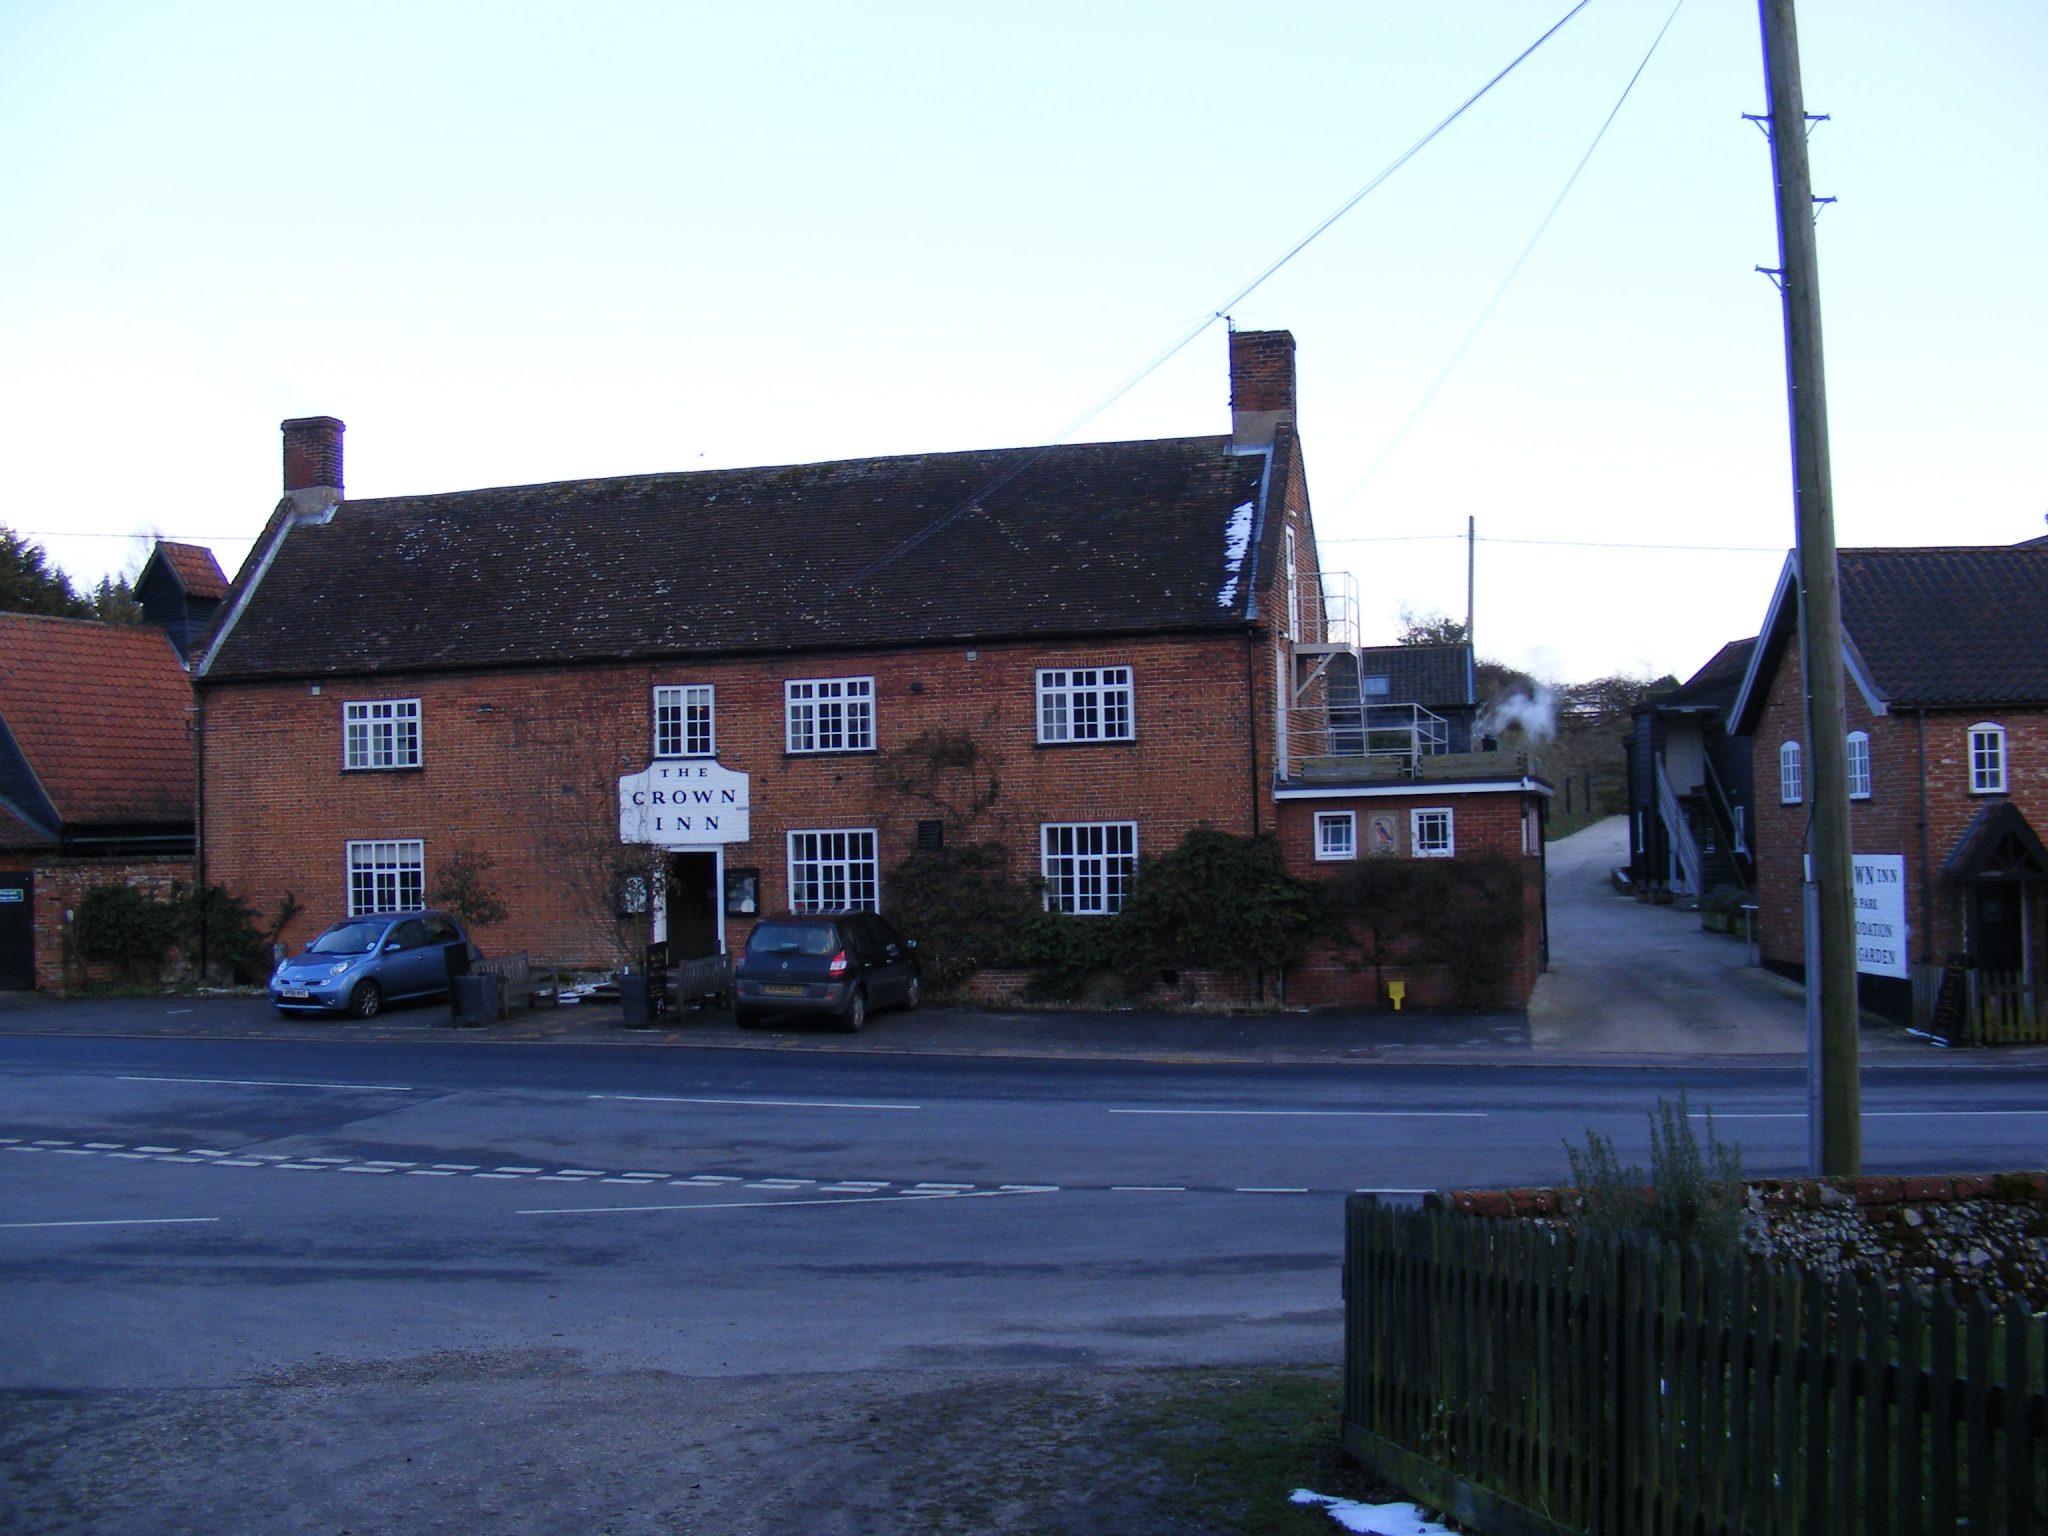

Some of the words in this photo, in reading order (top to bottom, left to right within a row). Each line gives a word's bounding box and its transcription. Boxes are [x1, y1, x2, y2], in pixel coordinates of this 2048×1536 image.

[660, 768, 708, 778] THE
[632, 789, 736, 806] CROWN
[656, 816, 719, 830] INN
[1854, 866, 1874, 885] WN
[1877, 868, 1898, 884] INN
[1856, 921, 1893, 938] ODATION
[1859, 947, 1896, 965] GARDEN
